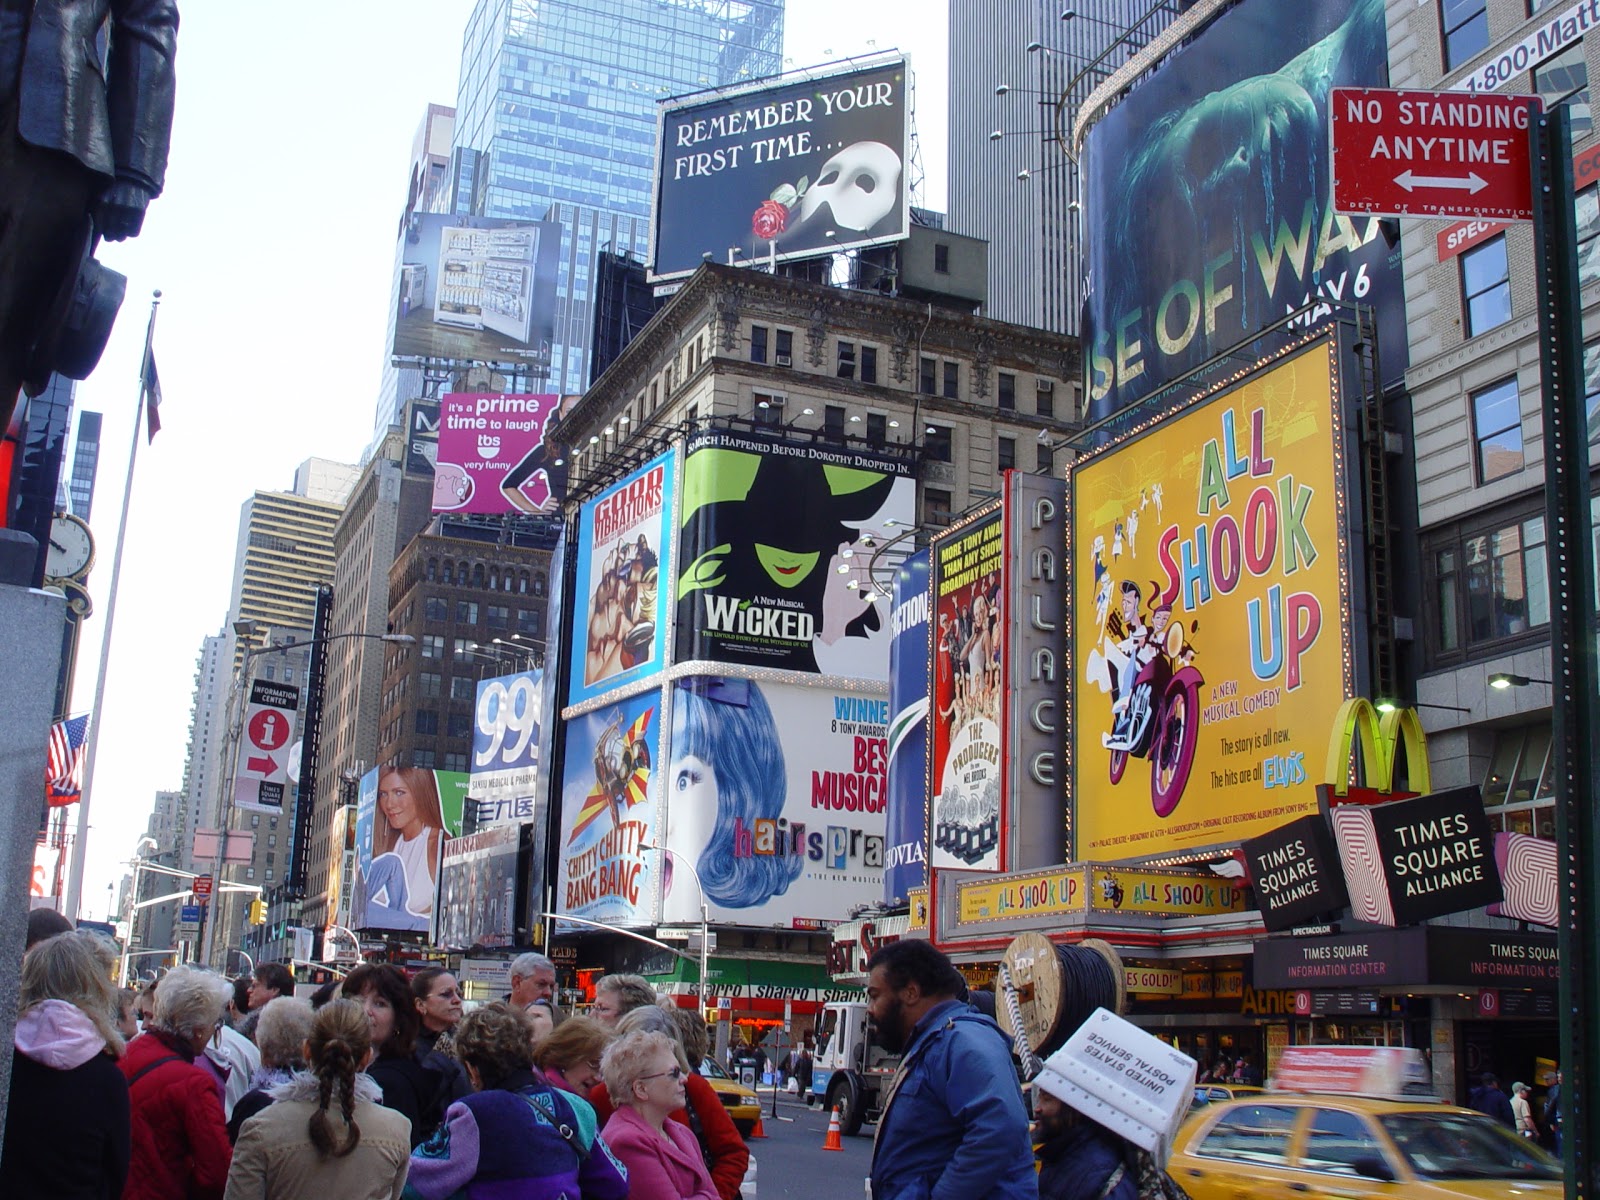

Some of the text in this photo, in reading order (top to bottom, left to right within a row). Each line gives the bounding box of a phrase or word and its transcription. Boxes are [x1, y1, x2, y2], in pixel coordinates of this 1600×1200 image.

[677, 82, 893, 147] REMEMBER YOUR
[1347, 99, 1529, 130] NO STANDING
[674, 145, 743, 180] FIRST
[1370, 135, 1510, 164] ANYTIME
[1350, 202, 1380, 210] DEPT
[1395, 204, 1409, 212] OF
[1156, 250, 1233, 356] OF
[1286, 262, 1371, 330] MAY 6
[476, 396, 540, 417] prime
[447, 414, 538, 432] time to laugh
[477, 434, 500, 447] tbs
[464, 459, 511, 472] very funny
[1198, 407, 1274, 516] ALL
[594, 466, 663, 523] GOOD
[595, 485, 662, 541] VIBRATIONS
[941, 541, 962, 563] MORE
[963, 532, 983, 551] TONY
[1158, 474, 1319, 613] SHOOK
[943, 556, 963, 578] THAN
[964, 549, 979, 569] ANY
[940, 569, 981, 597] BROADWAY
[753, 595, 760, 604] A
[1246, 583, 1323, 693] UP
[254, 685, 297, 700] INFORMATION
[262, 694, 287, 705] CENTER
[1212, 681, 1238, 701] A NEW
[1203, 687, 1281, 725] MUSICAL COMEDY
[831, 719, 837, 733] 8
[840, 722, 856, 735] TONY
[968, 721, 983, 743] THE
[1220, 738, 1233, 756] The
[1234, 732, 1253, 754] story
[1255, 733, 1261, 749] is
[1263, 728, 1272, 747] all
[952, 741, 999, 776] PRODUCERS
[489, 778, 509, 789] MEDICAL
[971, 768, 987, 783] BROOKS
[1210, 771, 1223, 789] The
[1224, 767, 1238, 787] hits
[1239, 766, 1251, 784] are
[1253, 762, 1262, 781] all
[1395, 813, 1469, 847] TIMES
[568, 821, 648, 879] CHITTY CHITTY
[1257, 839, 1306, 872] TIMES
[1393, 837, 1484, 876] SQUARE
[566, 859, 641, 910] BANG BANG
[1259, 858, 1318, 894] SQUARE
[1406, 865, 1484, 897] ALLIANCE
[998, 877, 1077, 913] ALL SHOOK UP
[1133, 882, 1240, 909] ALL SHOOK UP
[1269, 880, 1320, 910] ALLIANCE
[1292, 925, 1331, 937] SPECTACOLOR
[1303, 944, 1369, 960] TIMES SQUARE
[1490, 944, 1525, 958] TIMES
[1288, 962, 1386, 977] INFORMATION CENTER
[1471, 962, 1546, 978] INFORMATION
[756, 983, 809, 1000] sbarro
[1086, 1032, 1134, 1062] SERVICE
[1084, 1045, 1165, 1095] UNITED STATES
[1135, 1058, 1176, 1086] POSTAL
